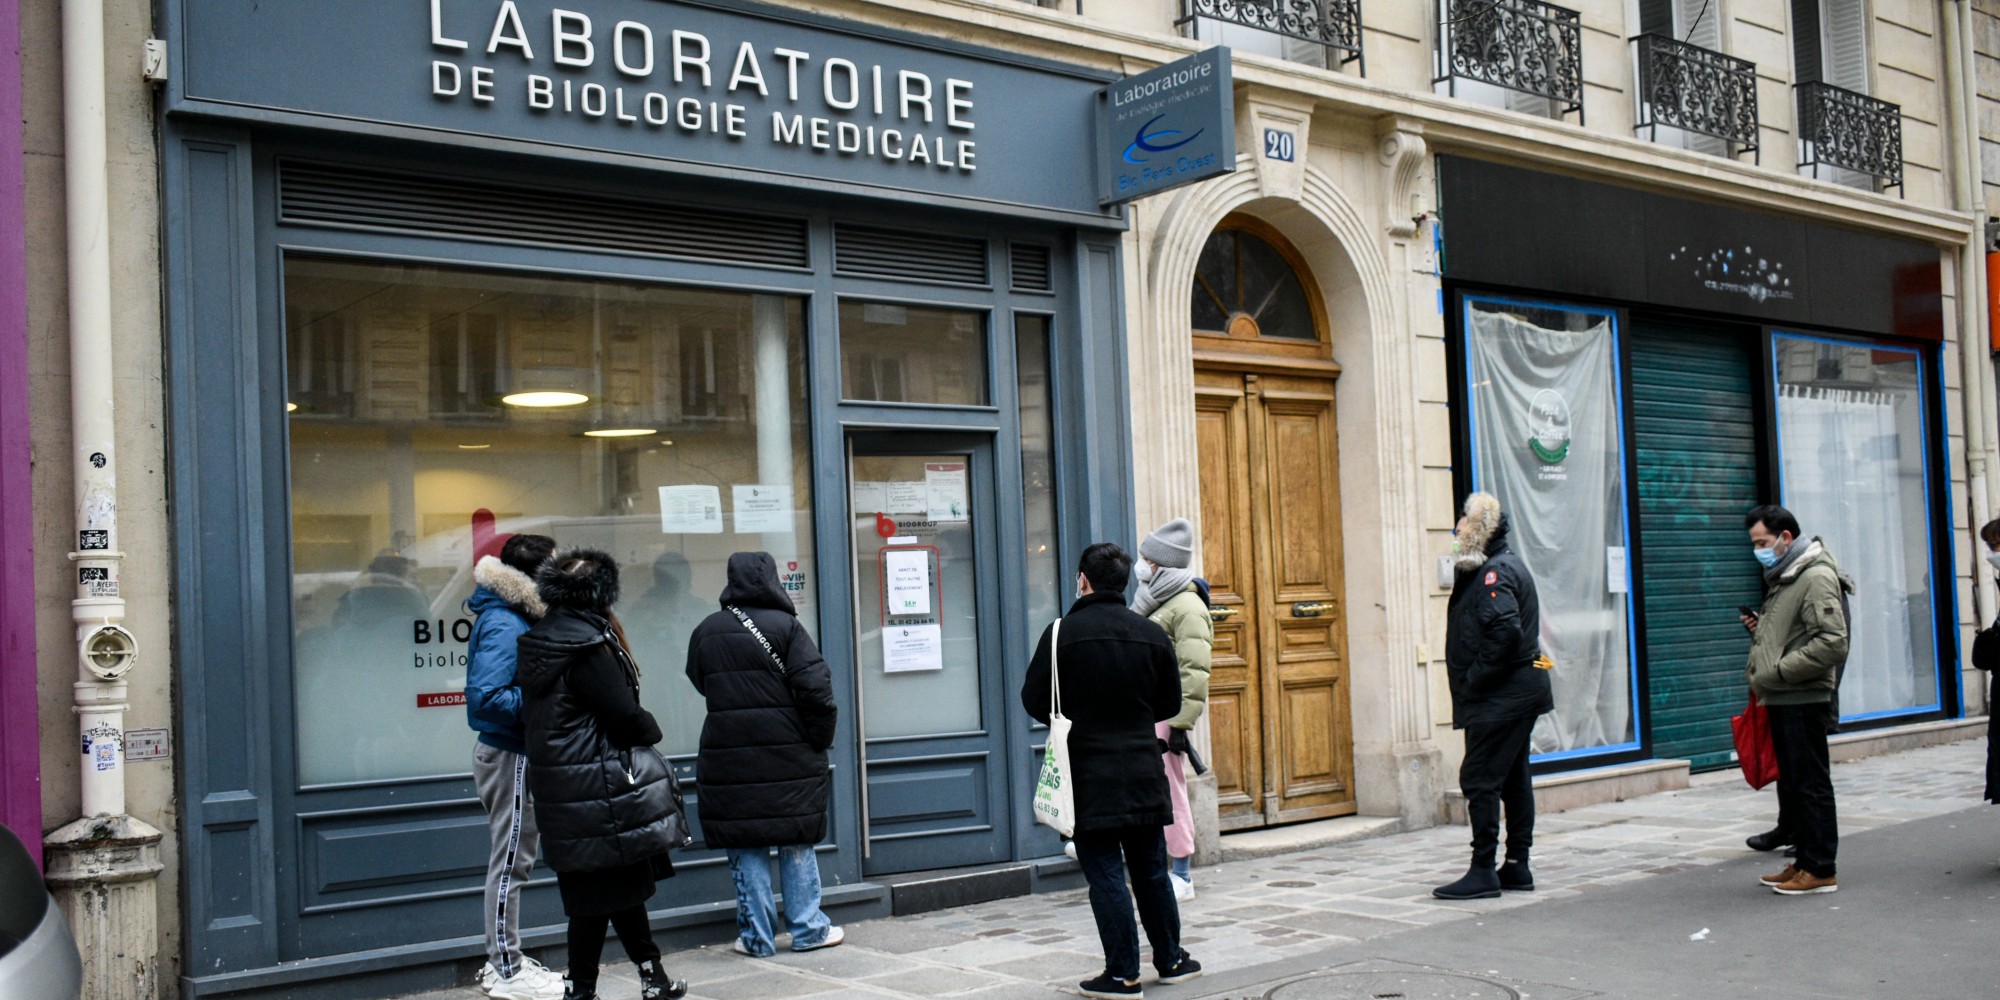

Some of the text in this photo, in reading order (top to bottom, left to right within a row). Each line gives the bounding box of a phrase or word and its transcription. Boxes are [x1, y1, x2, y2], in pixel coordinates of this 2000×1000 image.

[431, 0, 975, 129] LABORATOIRE
[1114, 62, 1211, 107] Laboratoire
[432, 60, 977, 171] DE BIOLOGIE MEDICALE
[1267, 131, 1292, 160] 20
[1142, 166, 1173, 184] Paris
[1177, 152, 1215, 174] Ouest
[782, 582, 806, 591] TEST
[787, 573, 805, 581] VIH
[748, 621, 774, 654] KANGOL
